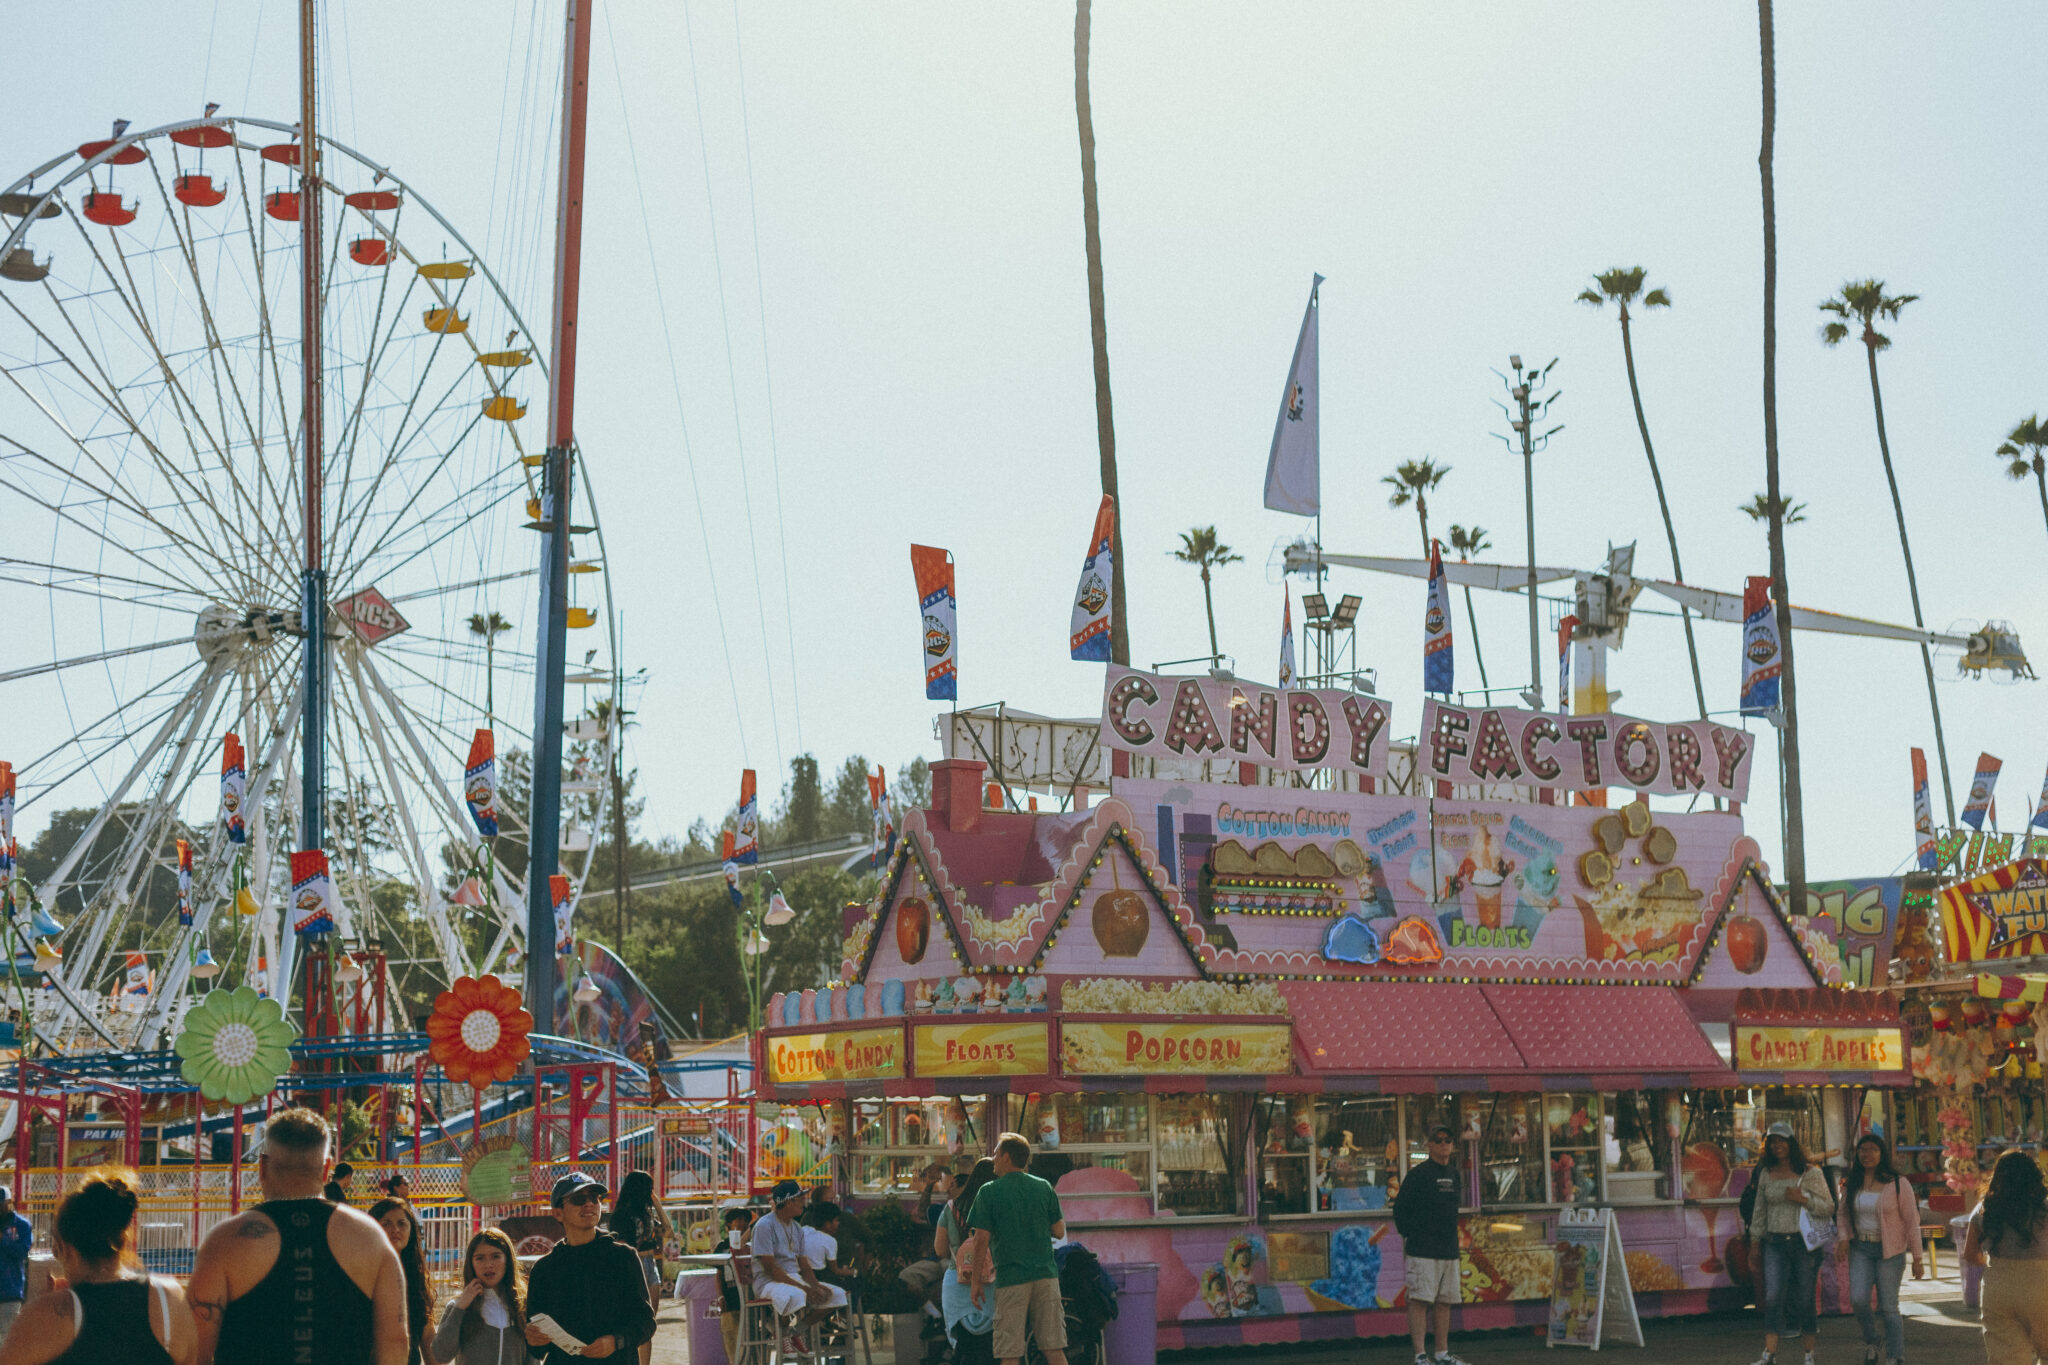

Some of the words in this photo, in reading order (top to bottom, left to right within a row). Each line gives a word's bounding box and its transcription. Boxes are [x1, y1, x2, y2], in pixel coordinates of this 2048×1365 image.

[352, 600, 396, 630] RCS
[1108, 676, 1386, 768] CANDY
[1430, 704, 1749, 792] FACTORY
[1218, 802, 1294, 839] COTTON
[1296, 807, 1351, 837] CANDY
[1990, 887, 2048, 916] WAT
[1452, 920, 1531, 949] FLOATS
[2003, 913, 2048, 939] FU
[777, 1044, 836, 1075] COTTON
[844, 1039, 894, 1071] CANDY
[945, 1039, 1016, 1063] FLOATS
[1125, 1029, 1242, 1063] POPCORN
[1751, 1032, 1809, 1061] CANDY
[1822, 1034, 1887, 1062] APPLES
[83, 1129, 108, 1139] PAY
